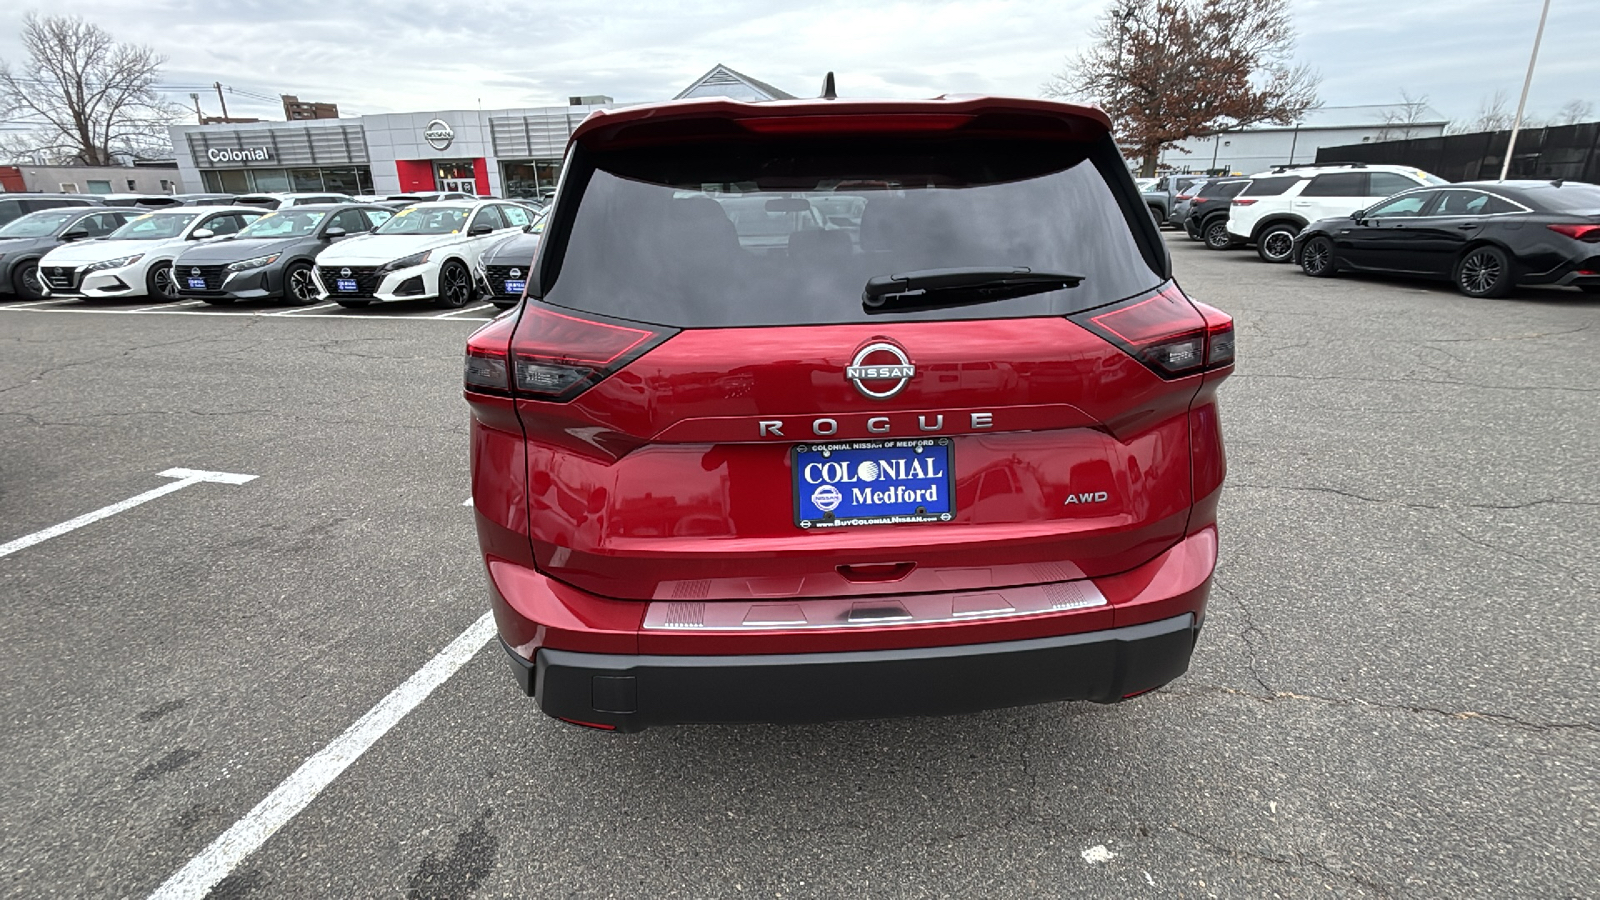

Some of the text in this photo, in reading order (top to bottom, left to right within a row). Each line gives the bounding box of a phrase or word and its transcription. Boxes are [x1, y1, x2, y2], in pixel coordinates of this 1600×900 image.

[208, 147, 270, 163] Colonial
[847, 367, 914, 378] NISSAN
[758, 412, 994, 437] ROGUE
[812, 439, 934, 452] COLONIAL NISSAN OF MEDFORD
[804, 457, 943, 484] COLONIAL
[851, 484, 938, 505] Medford
[1064, 491, 1109, 505] AWD
